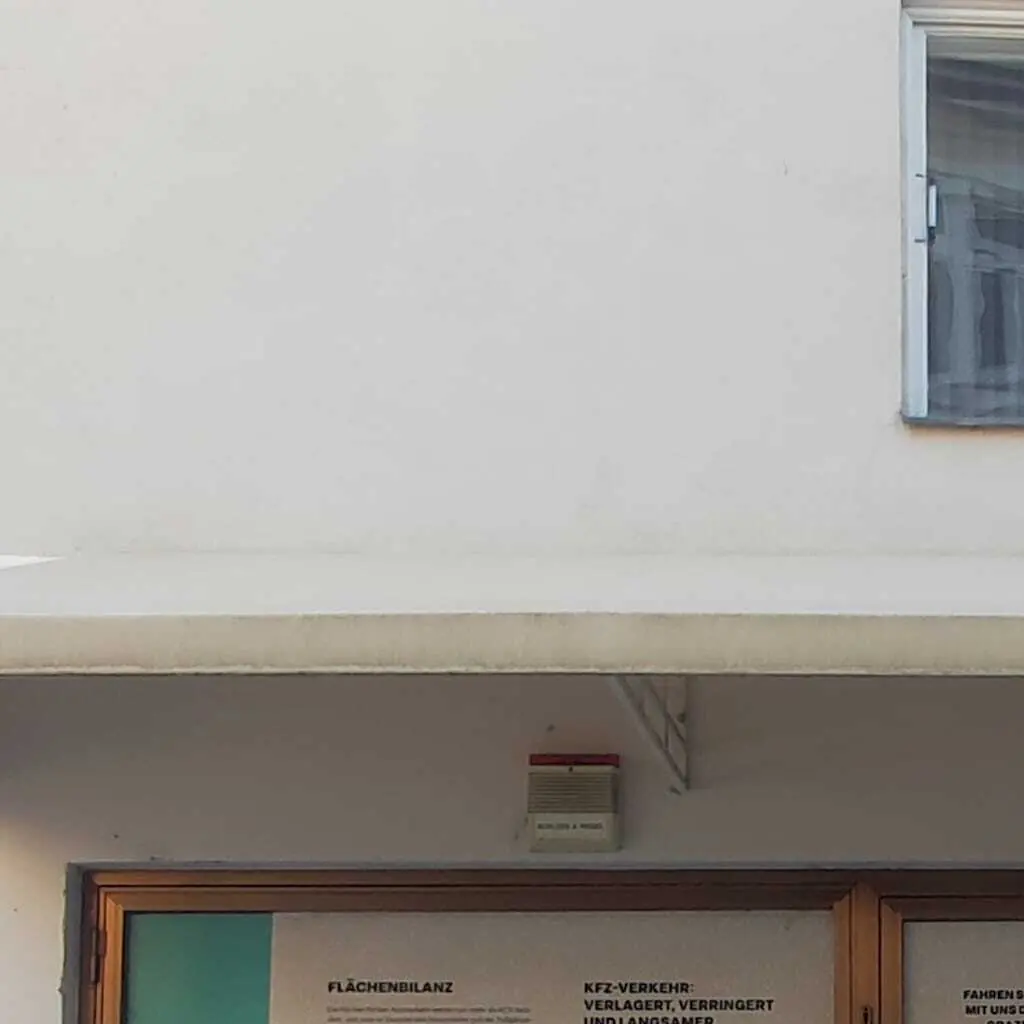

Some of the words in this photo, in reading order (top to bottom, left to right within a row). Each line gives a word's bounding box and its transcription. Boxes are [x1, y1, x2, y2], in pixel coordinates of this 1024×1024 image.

[328, 978, 453, 993] FLÄCHENBILANZ
[584, 982, 694, 994] KFZ-VERKEHR:
[963, 989, 1014, 1000] FAHREN
[584, 999, 676, 1012] VERLAGERT,
[678, 999, 774, 1011] VERRINGERT
[965, 1005, 987, 1015] MIT
[990, 1005, 1017, 1015] UNS
